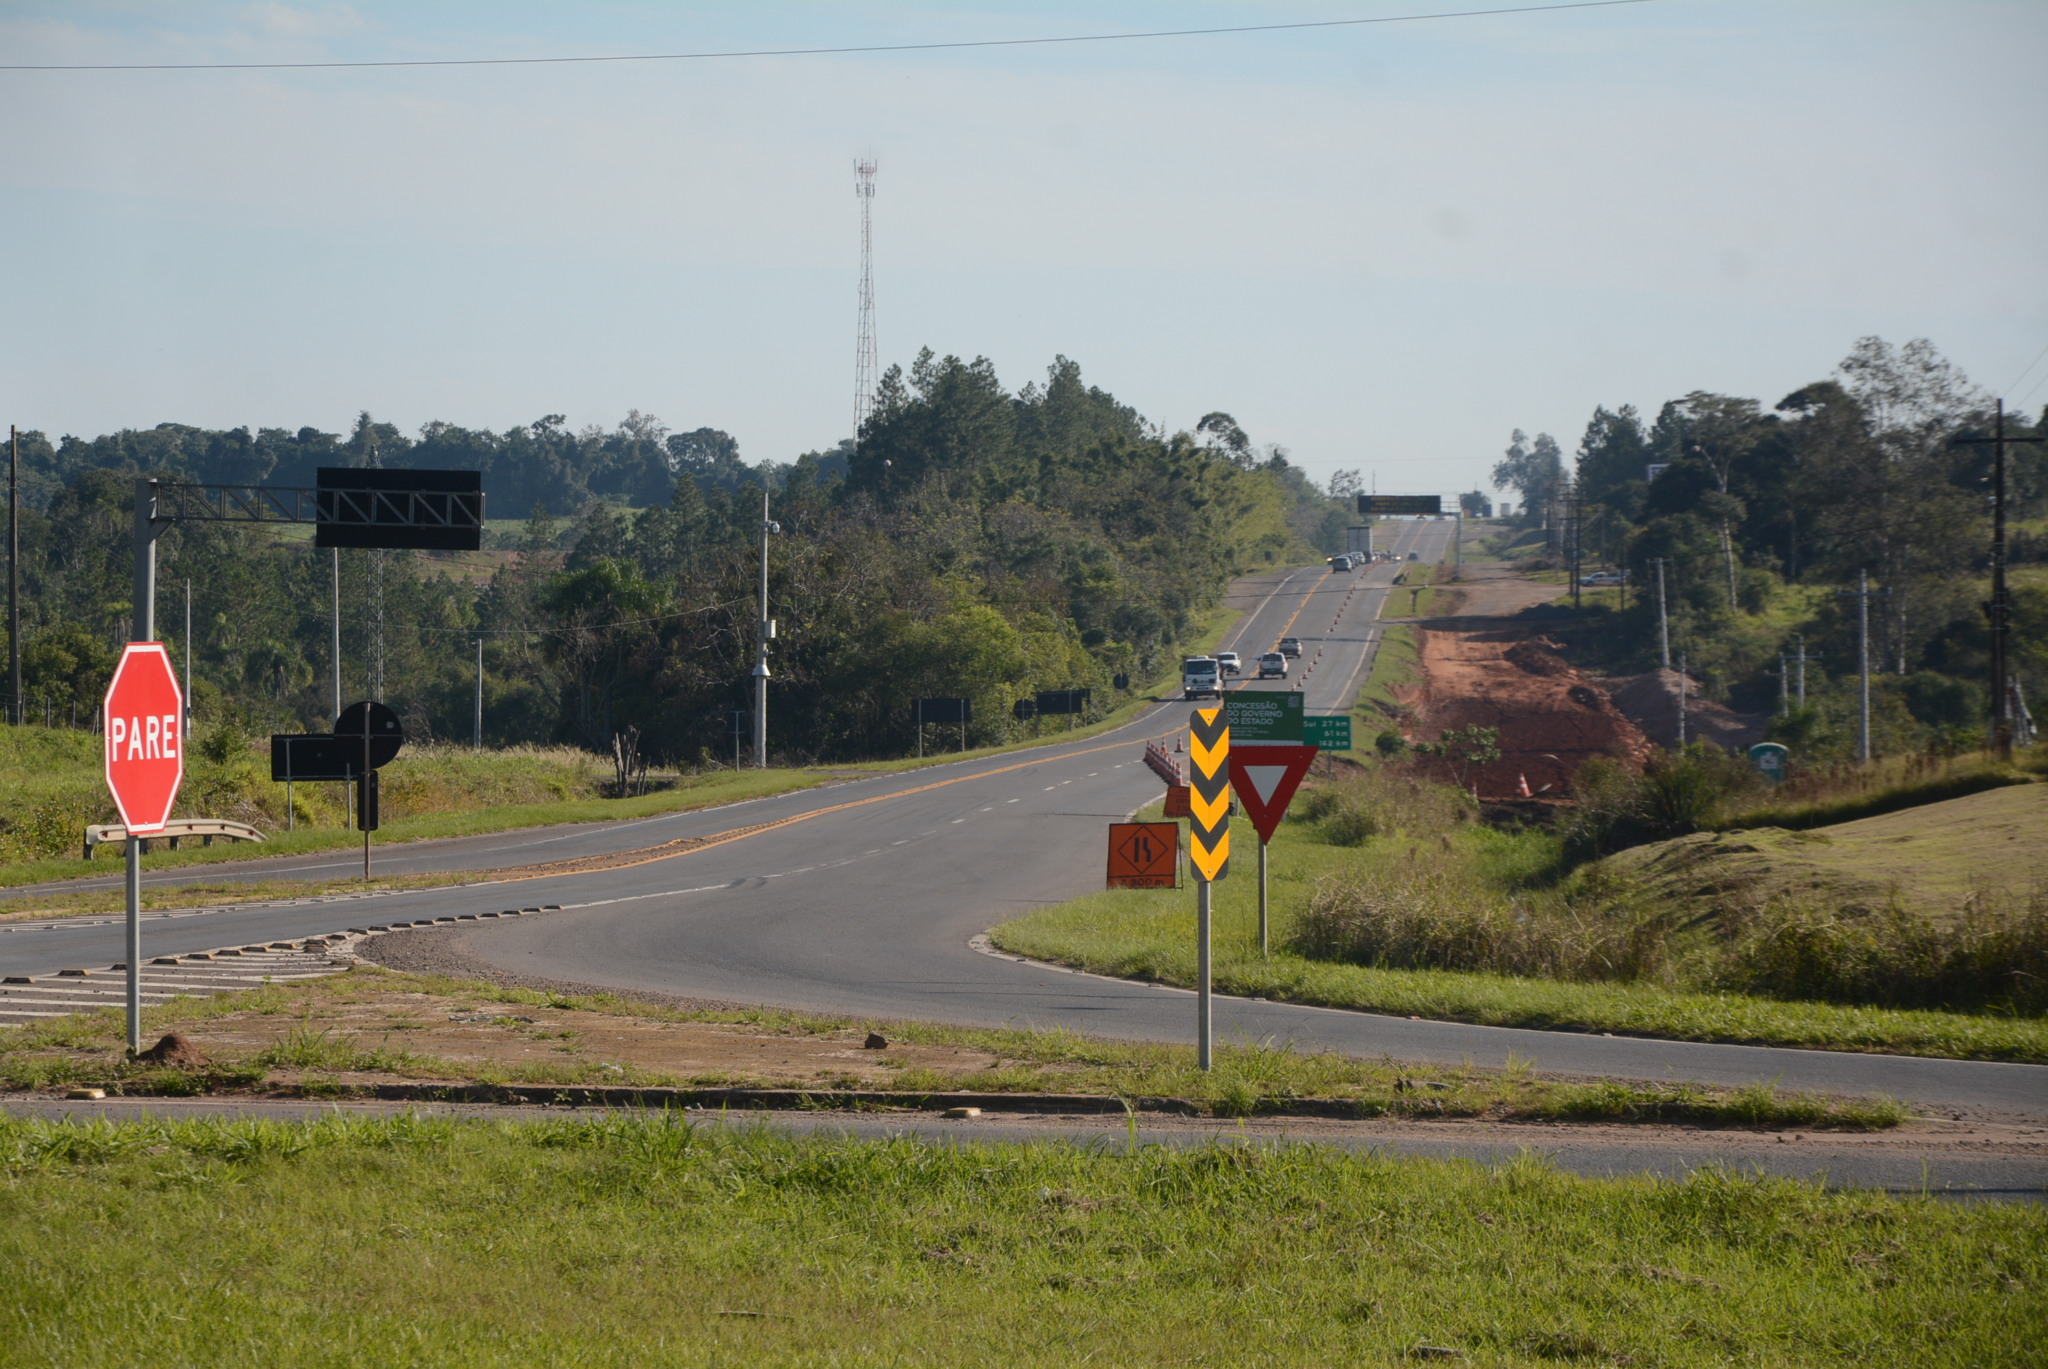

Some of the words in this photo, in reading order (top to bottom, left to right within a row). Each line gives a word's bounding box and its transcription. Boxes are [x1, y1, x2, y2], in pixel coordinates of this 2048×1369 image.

[1226, 701, 1278, 710] CONCESSÃO
[1241, 710, 1283, 718] GOVERNO
[1241, 717, 1274, 725] ESTADO
[112, 715, 176, 762] PARE
